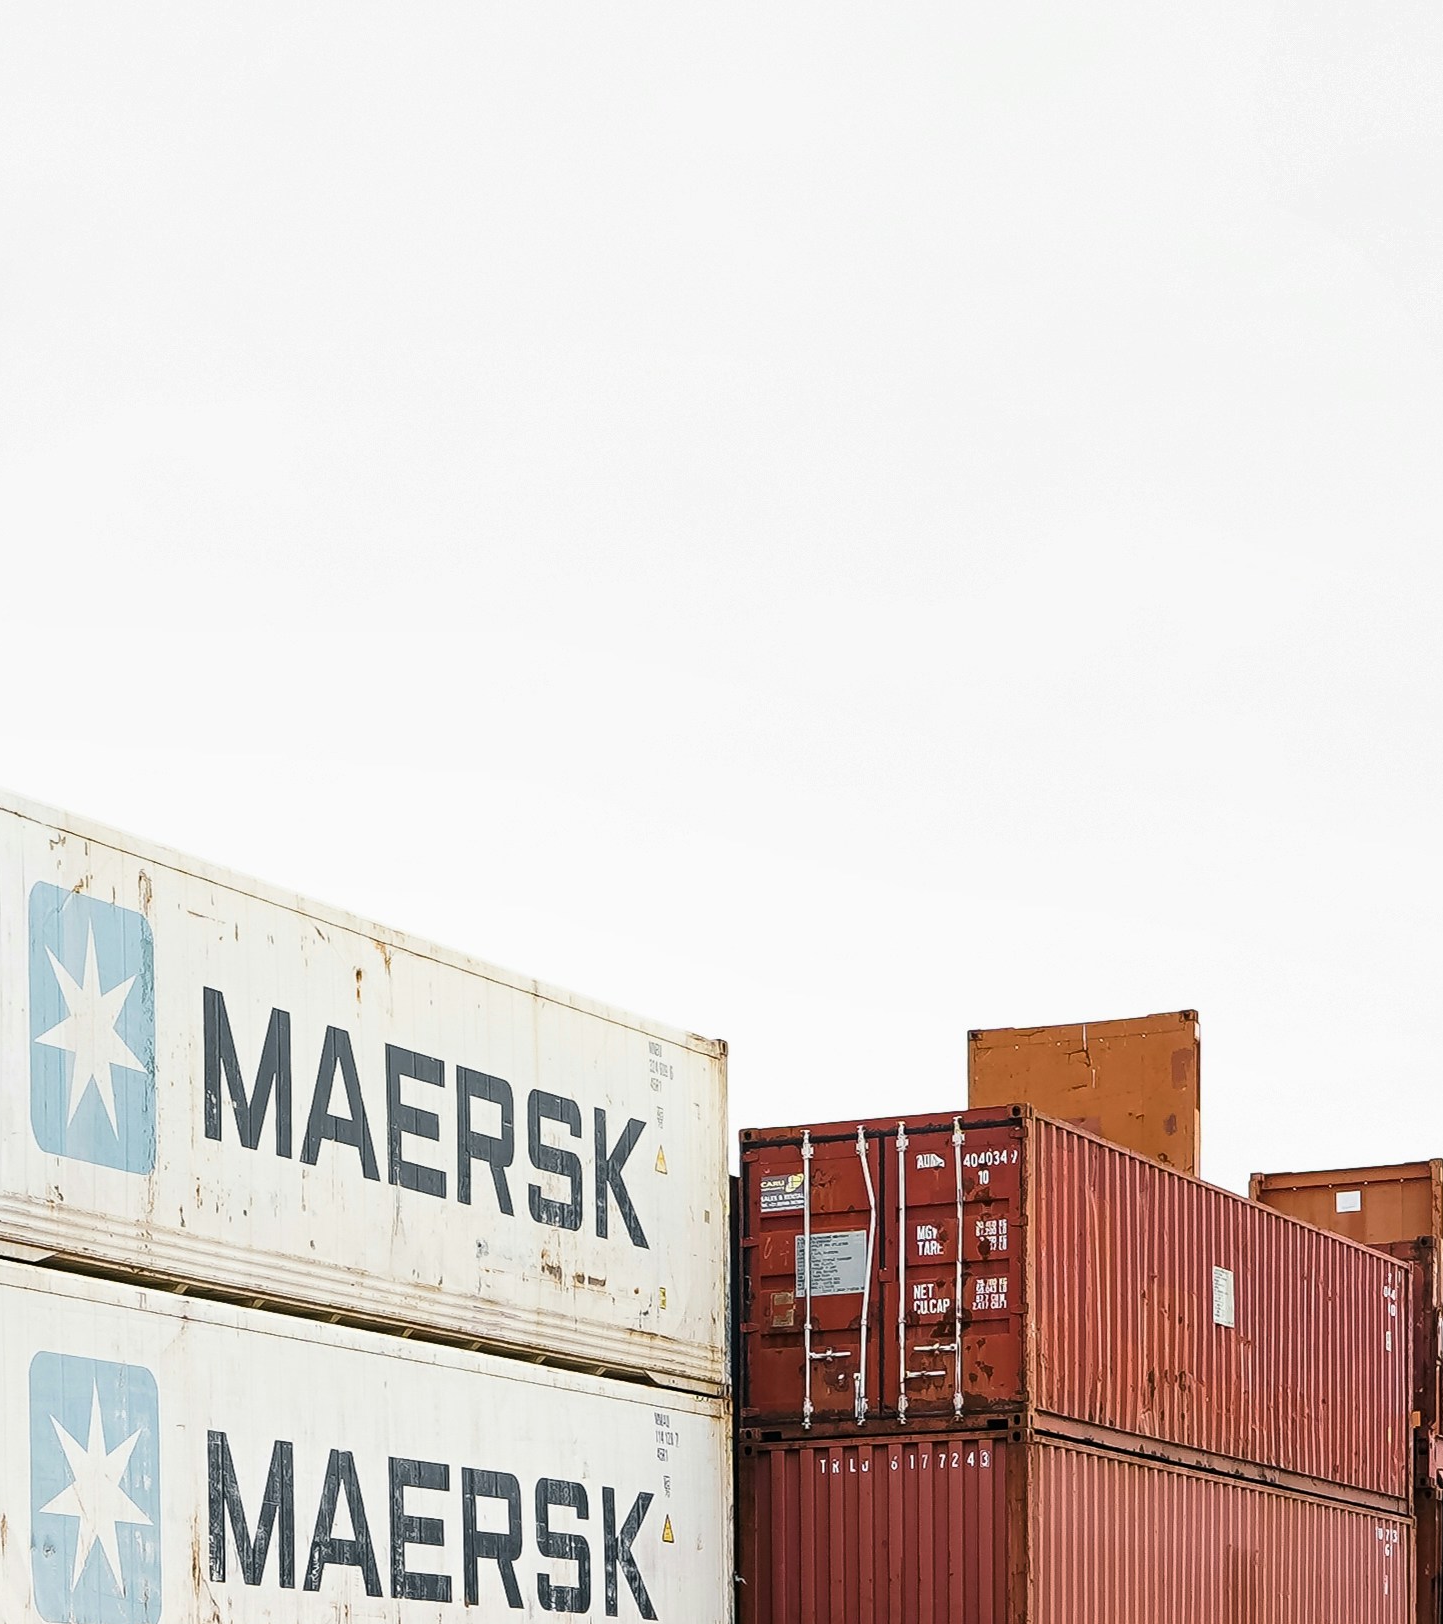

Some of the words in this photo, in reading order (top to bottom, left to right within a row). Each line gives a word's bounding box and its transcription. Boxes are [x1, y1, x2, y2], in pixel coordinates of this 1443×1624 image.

[203, 986, 650, 1250] MAERSK
[913, 1284, 934, 1300] NET
[207, 1429, 659, 1621] MAERSK
